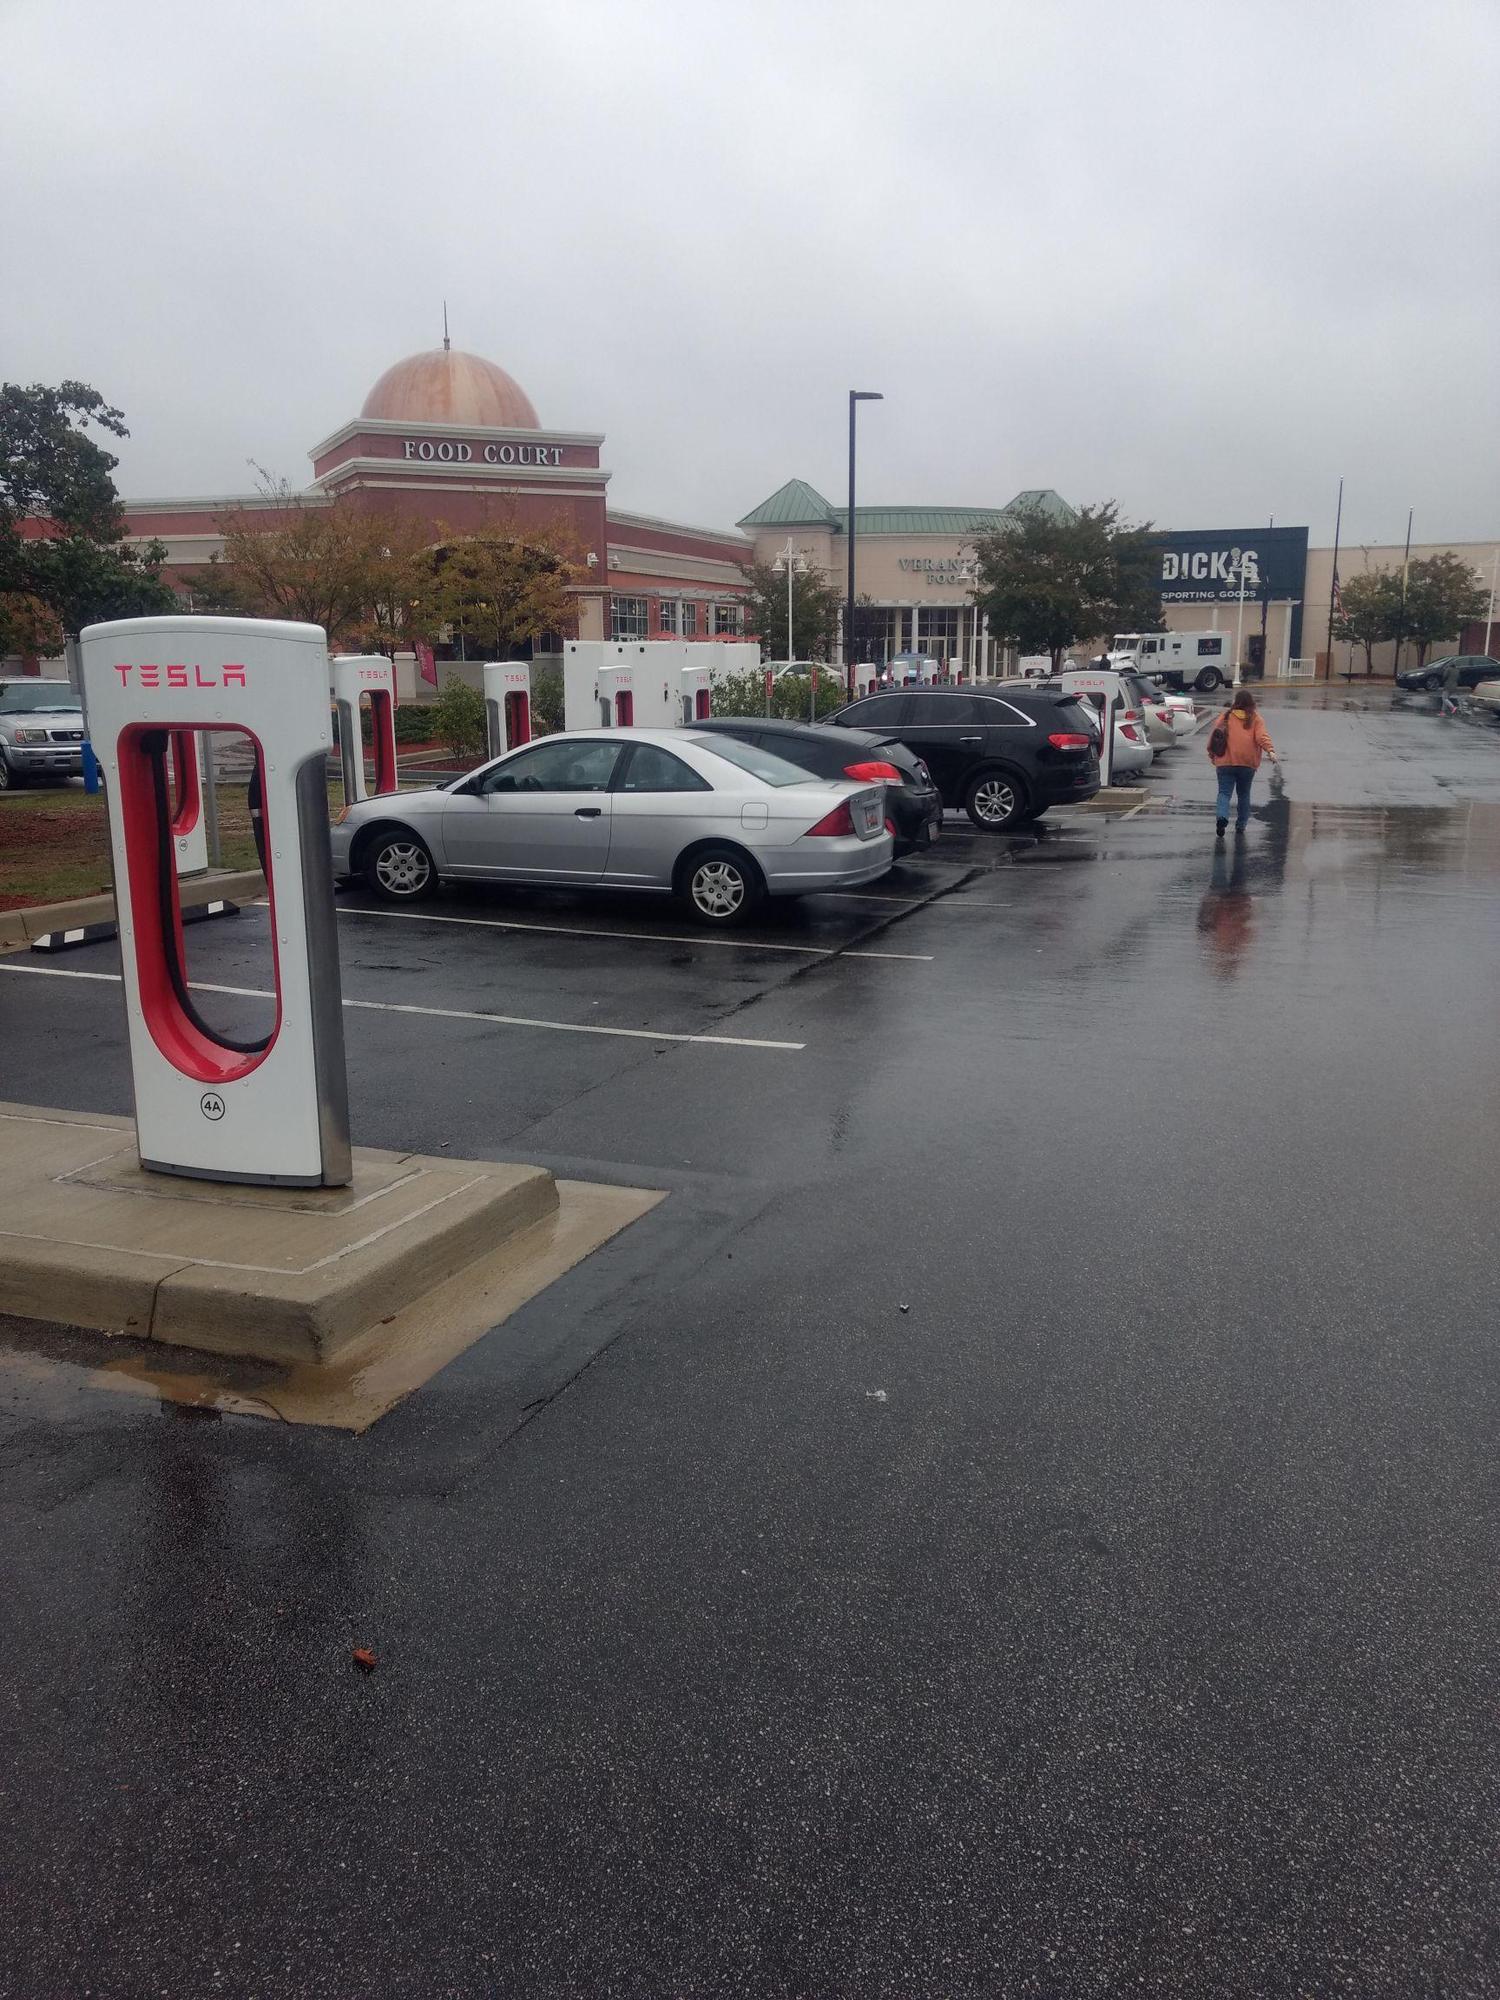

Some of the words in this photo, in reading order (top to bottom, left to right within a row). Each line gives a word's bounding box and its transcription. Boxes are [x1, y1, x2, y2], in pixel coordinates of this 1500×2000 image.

[404, 441, 473, 462] FOOD
[484, 445, 564, 466] COURT
[1161, 591, 1216, 600] SPORTING
[1219, 590, 1257, 599] GOODS
[113, 664, 246, 687] TESLA
[359, 670, 388, 679] TESLA
[204, 1100, 222, 1113] 4A
